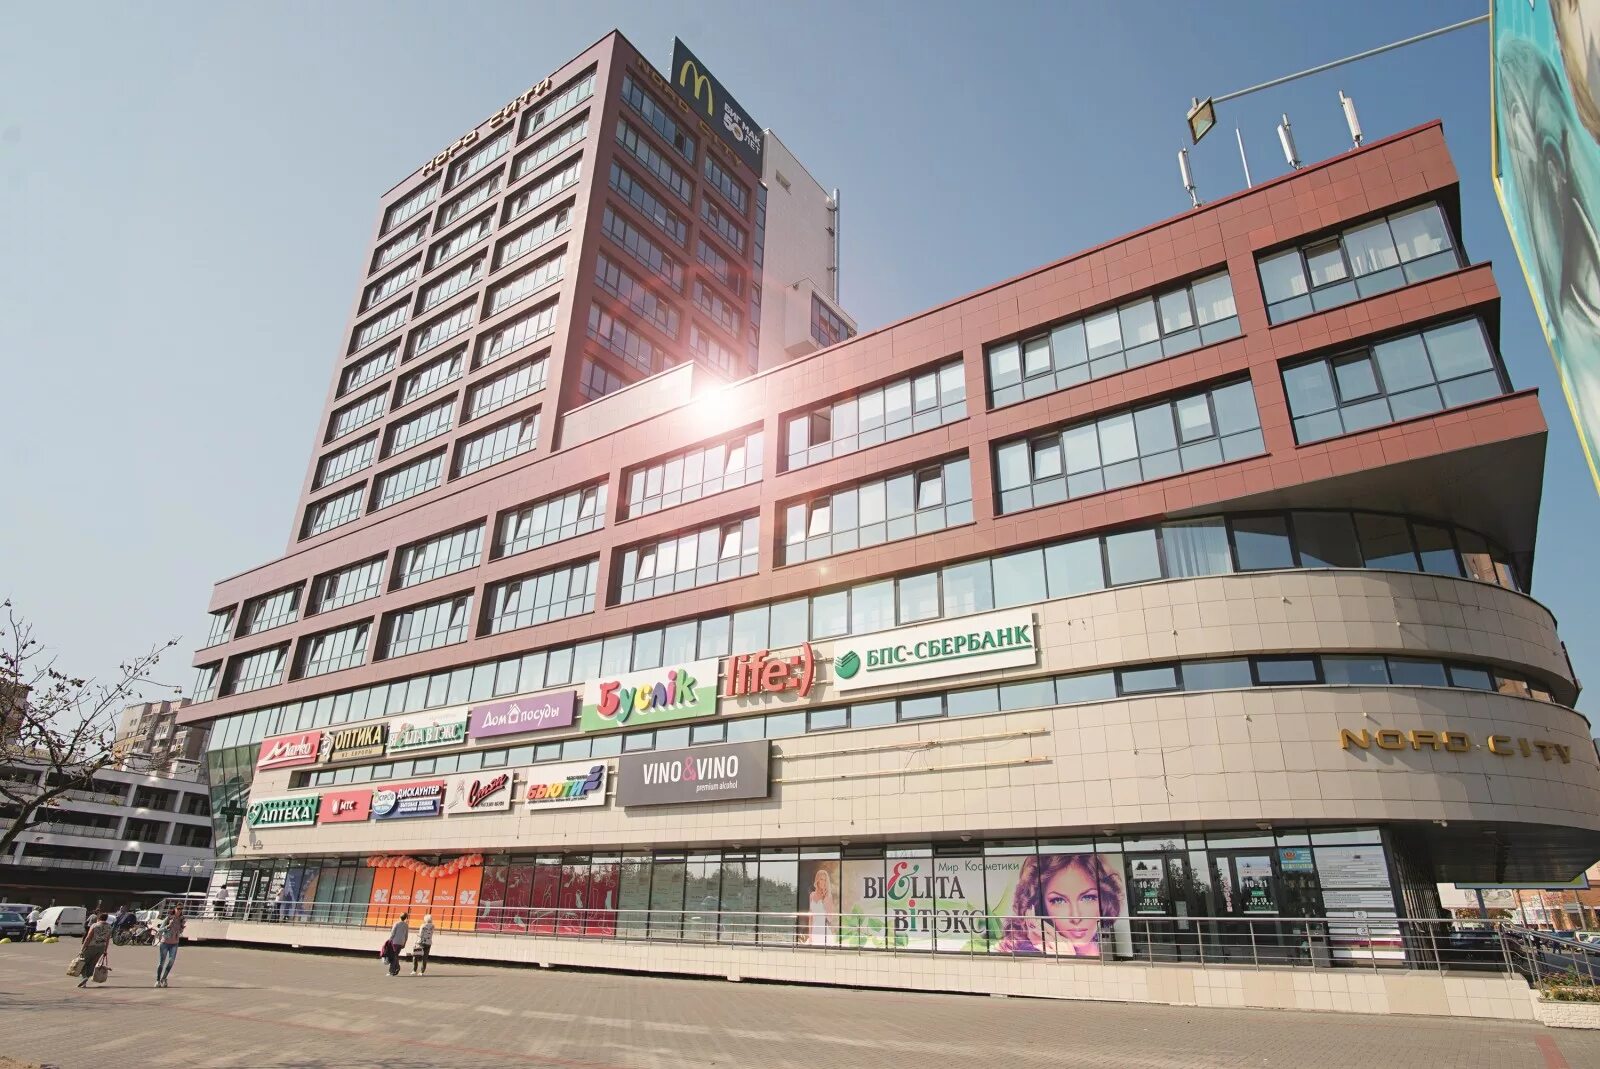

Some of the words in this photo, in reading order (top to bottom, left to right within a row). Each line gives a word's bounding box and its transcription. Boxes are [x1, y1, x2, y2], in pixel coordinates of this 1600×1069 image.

[723, 112, 744, 142] 50
[744, 134, 761, 155] ЛЕТ
[724, 101, 742, 124] БИГ
[742, 121, 761, 146] МАК
[866, 624, 1031, 667] БПС-СБЕРБАНК
[482, 711, 507, 729] Дом
[520, 703, 560, 727] посуды
[261, 735, 314, 762] Marko
[334, 725, 382, 750] ОПТИКА
[1339, 727, 1471, 753] NORD
[1487, 735, 1571, 764] CITY
[397, 785, 440, 799] ДИСКАУНТЕР
[696, 782, 719, 793] premium
[719, 780, 738, 790] alcohol
[260, 805, 310, 822] АПТЕКА
[340, 800, 354, 810] МТС
[938, 862, 959, 874] Мир
[965, 860, 1020, 871] Косметики
